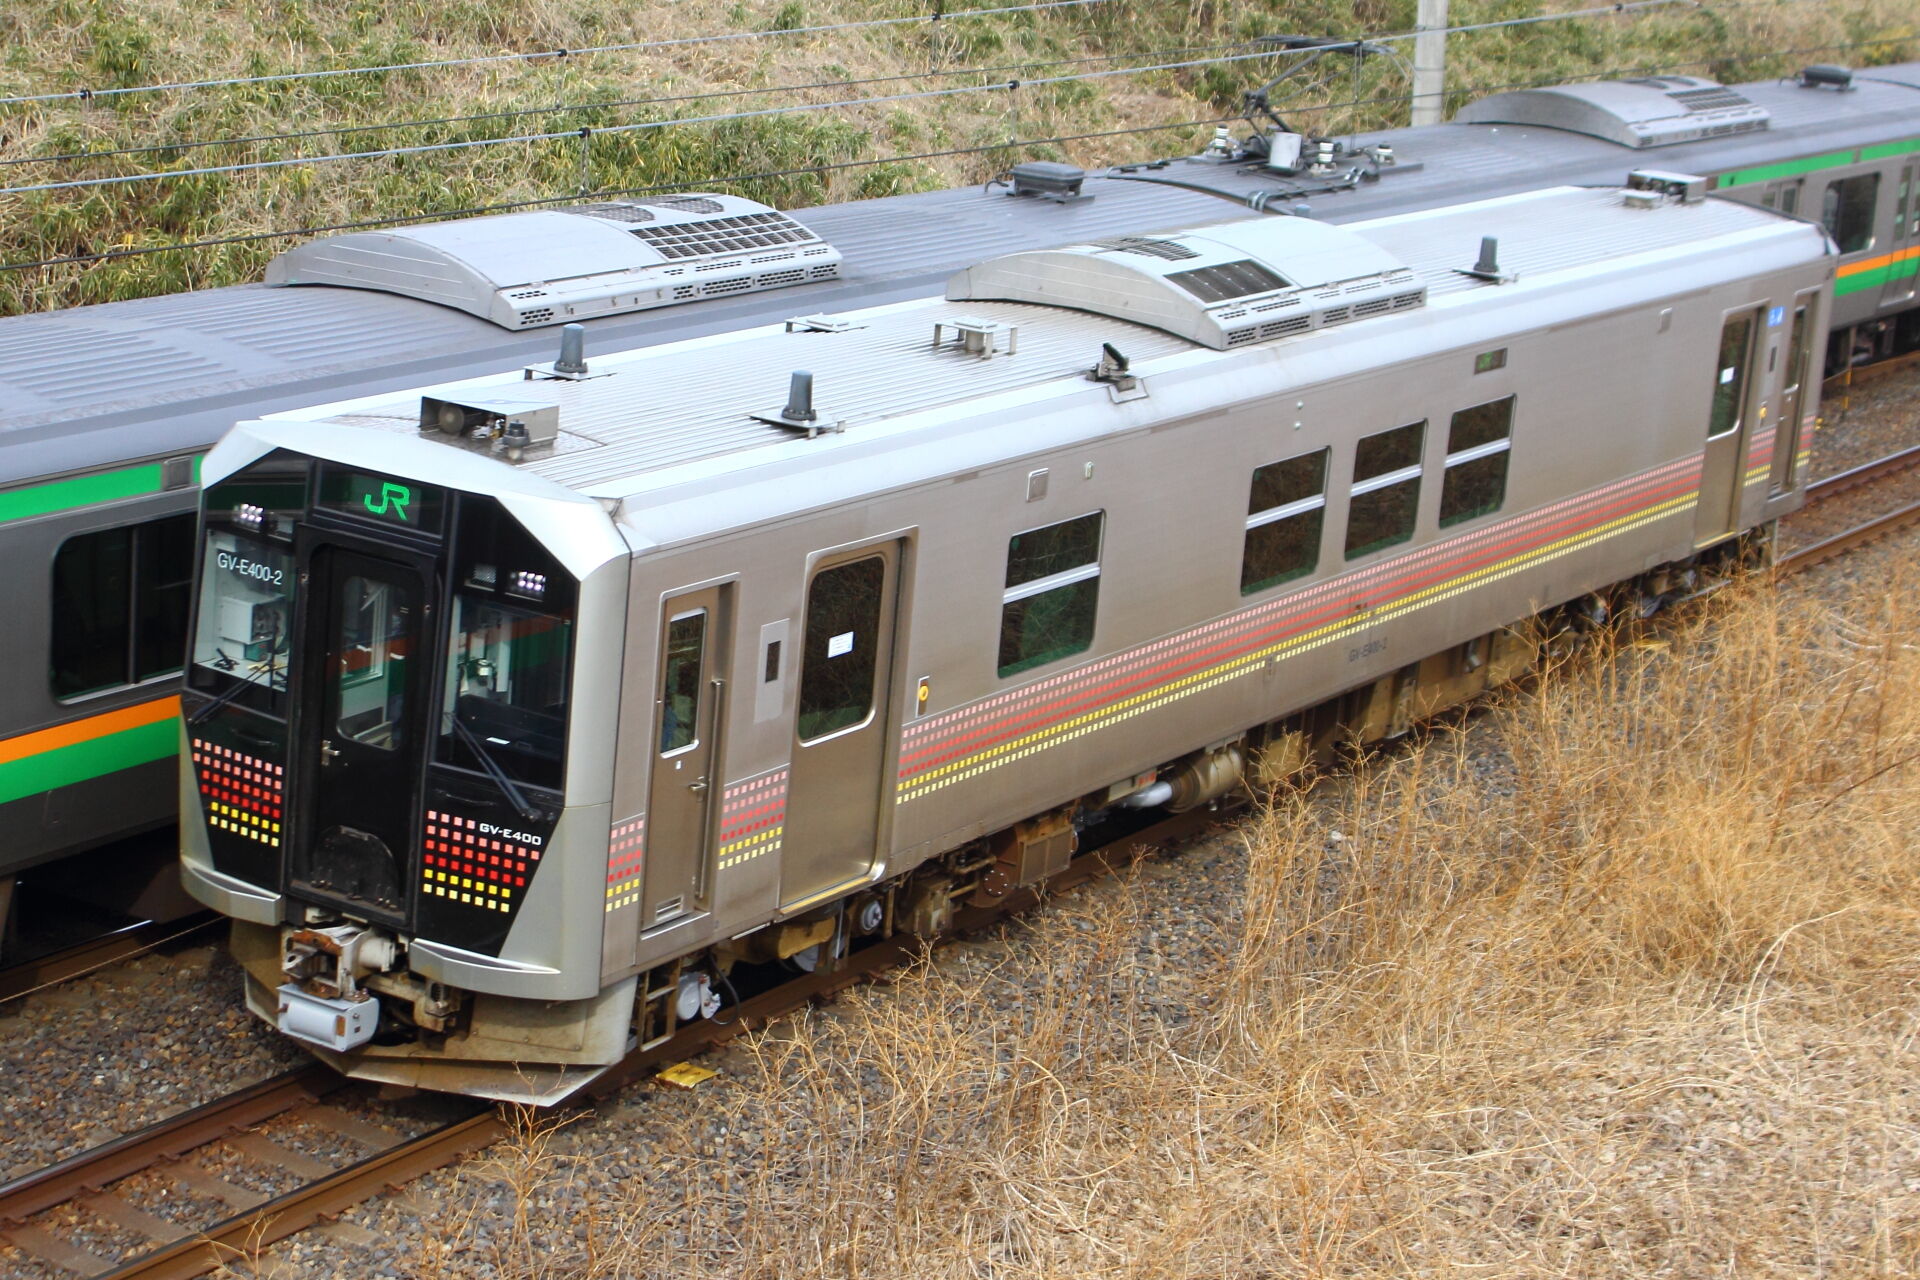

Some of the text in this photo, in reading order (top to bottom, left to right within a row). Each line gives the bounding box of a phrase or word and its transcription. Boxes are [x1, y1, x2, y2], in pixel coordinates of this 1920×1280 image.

[364, 482, 409, 520] JR
[217, 552, 283, 585] GV-E400-2
[479, 823, 542, 845] GV-E400
